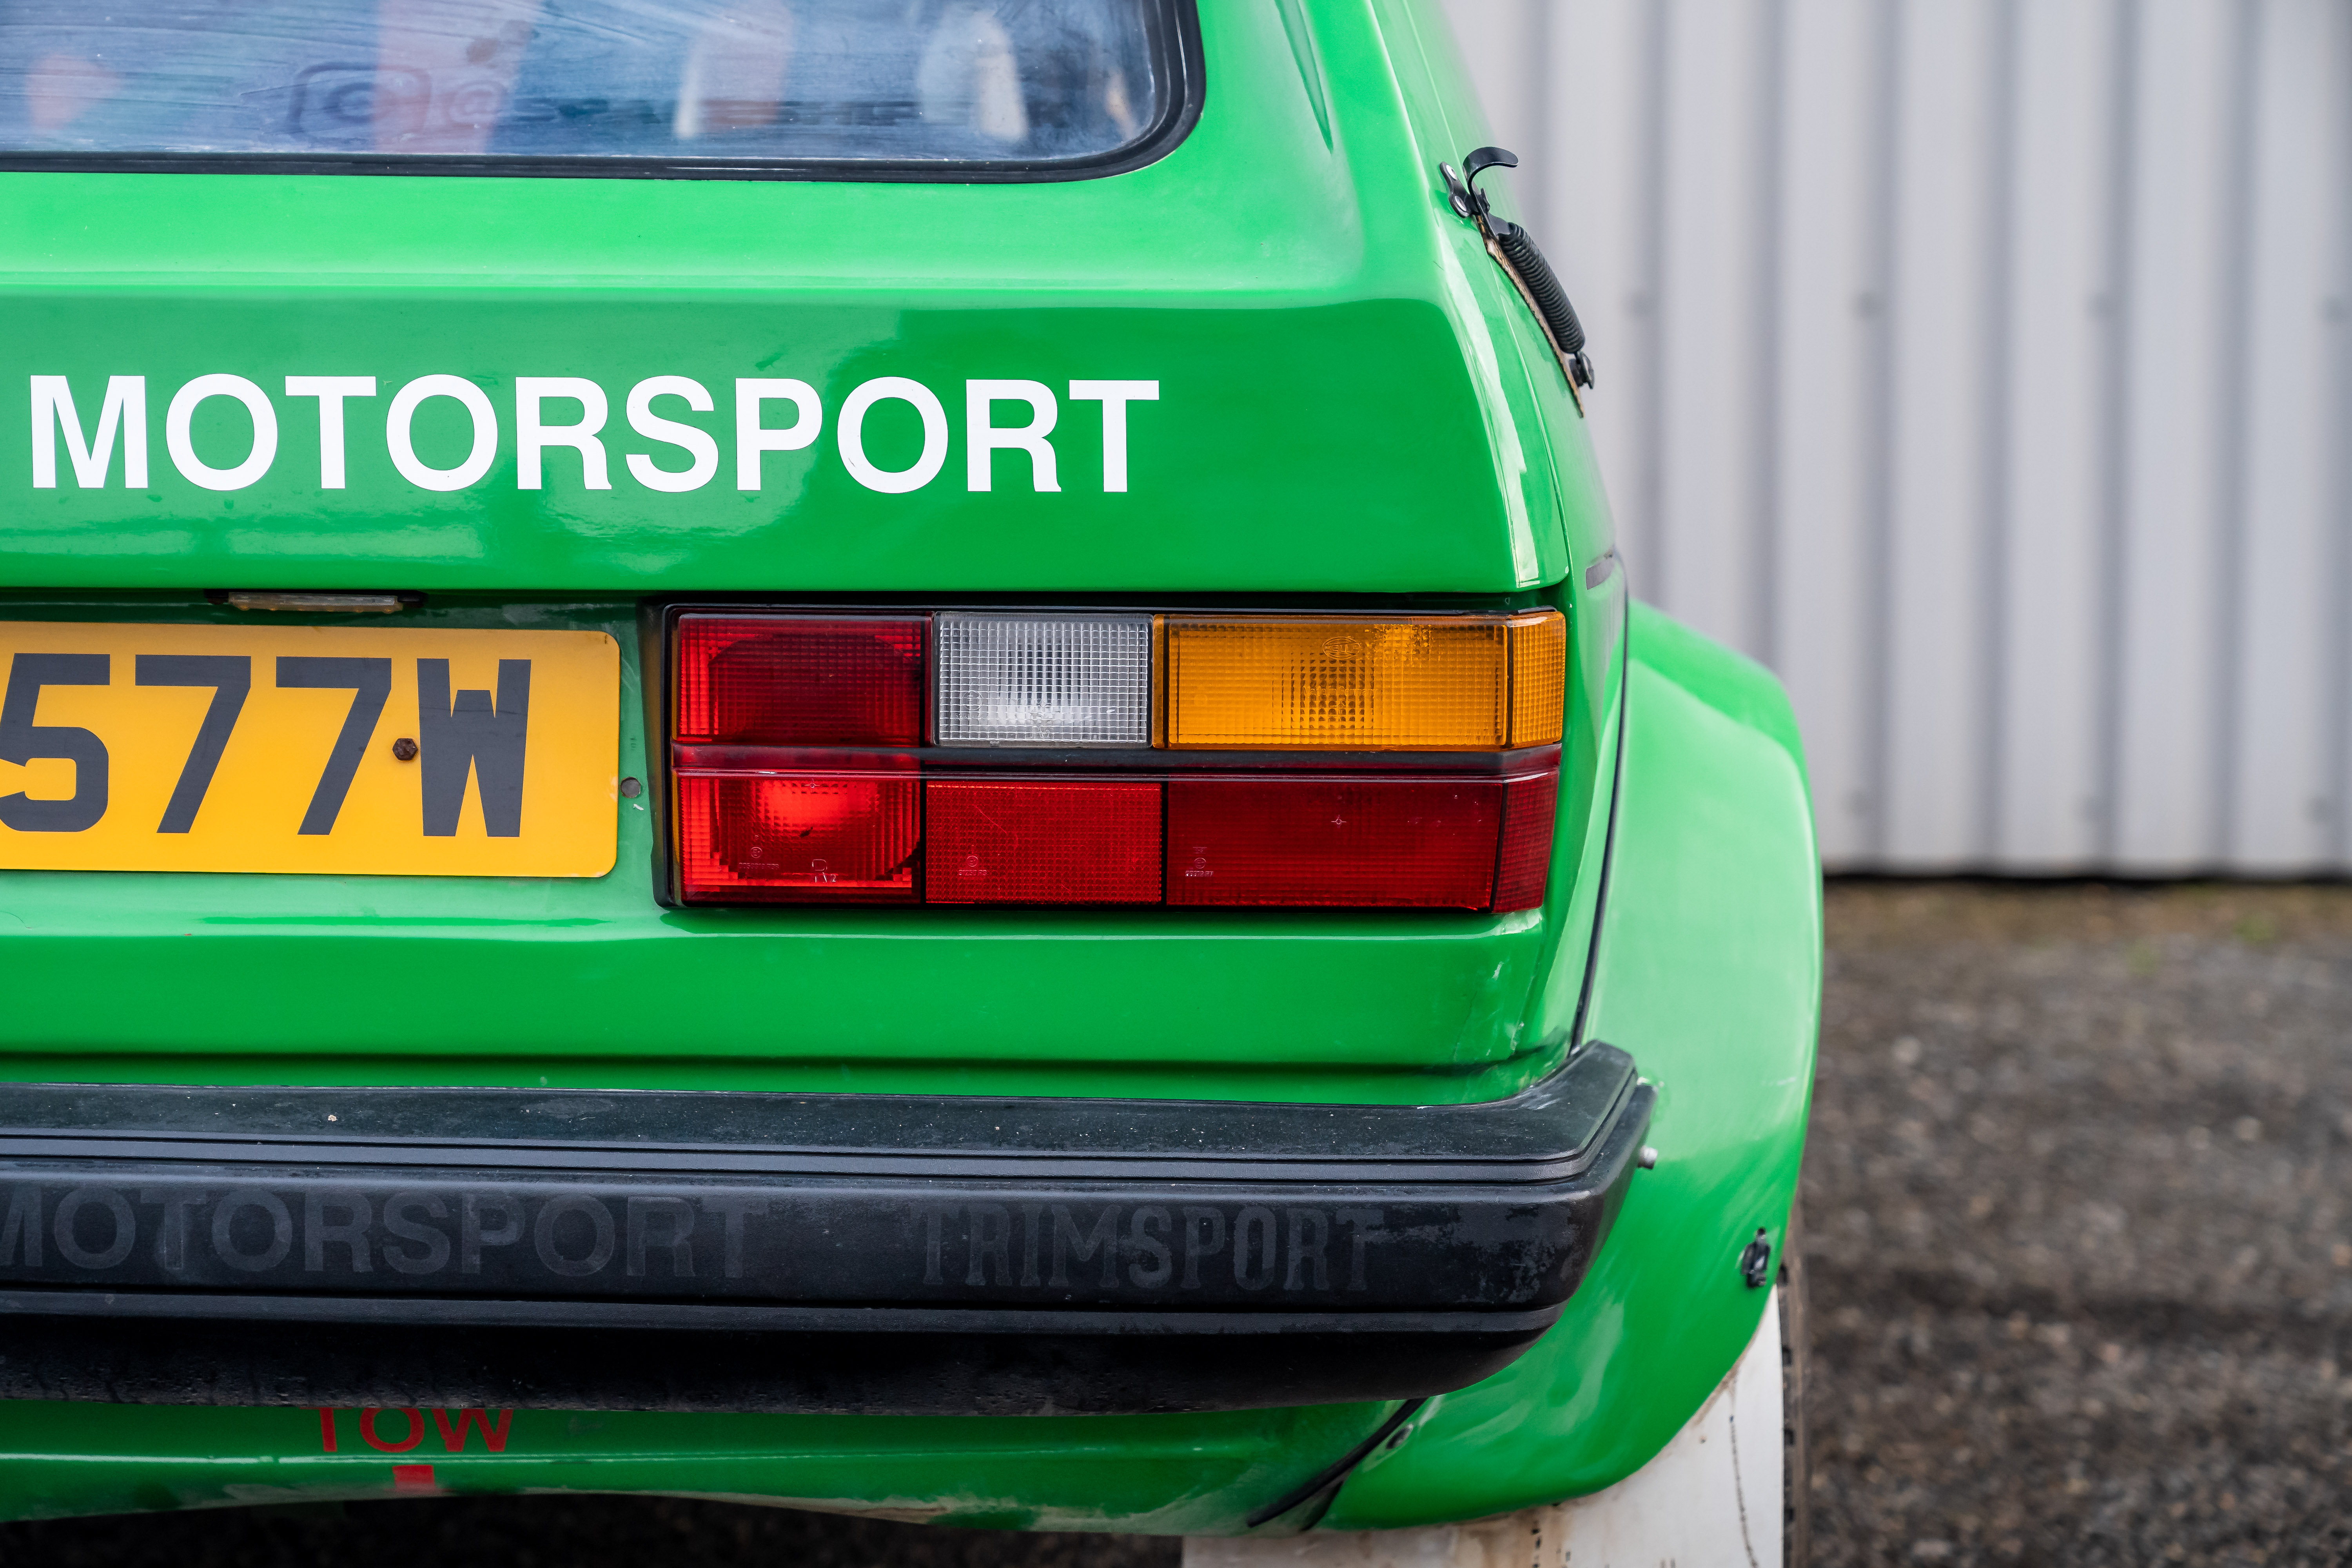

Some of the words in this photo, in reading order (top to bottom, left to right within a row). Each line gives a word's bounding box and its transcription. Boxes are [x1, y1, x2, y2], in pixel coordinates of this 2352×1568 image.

[31, 374, 1159, 493] MOTORSPORT
[0, 653, 531, 837] 577W
[909, 1201, 1385, 1291] TRIMSPORT
[299, 1406, 513, 1453] TOW
